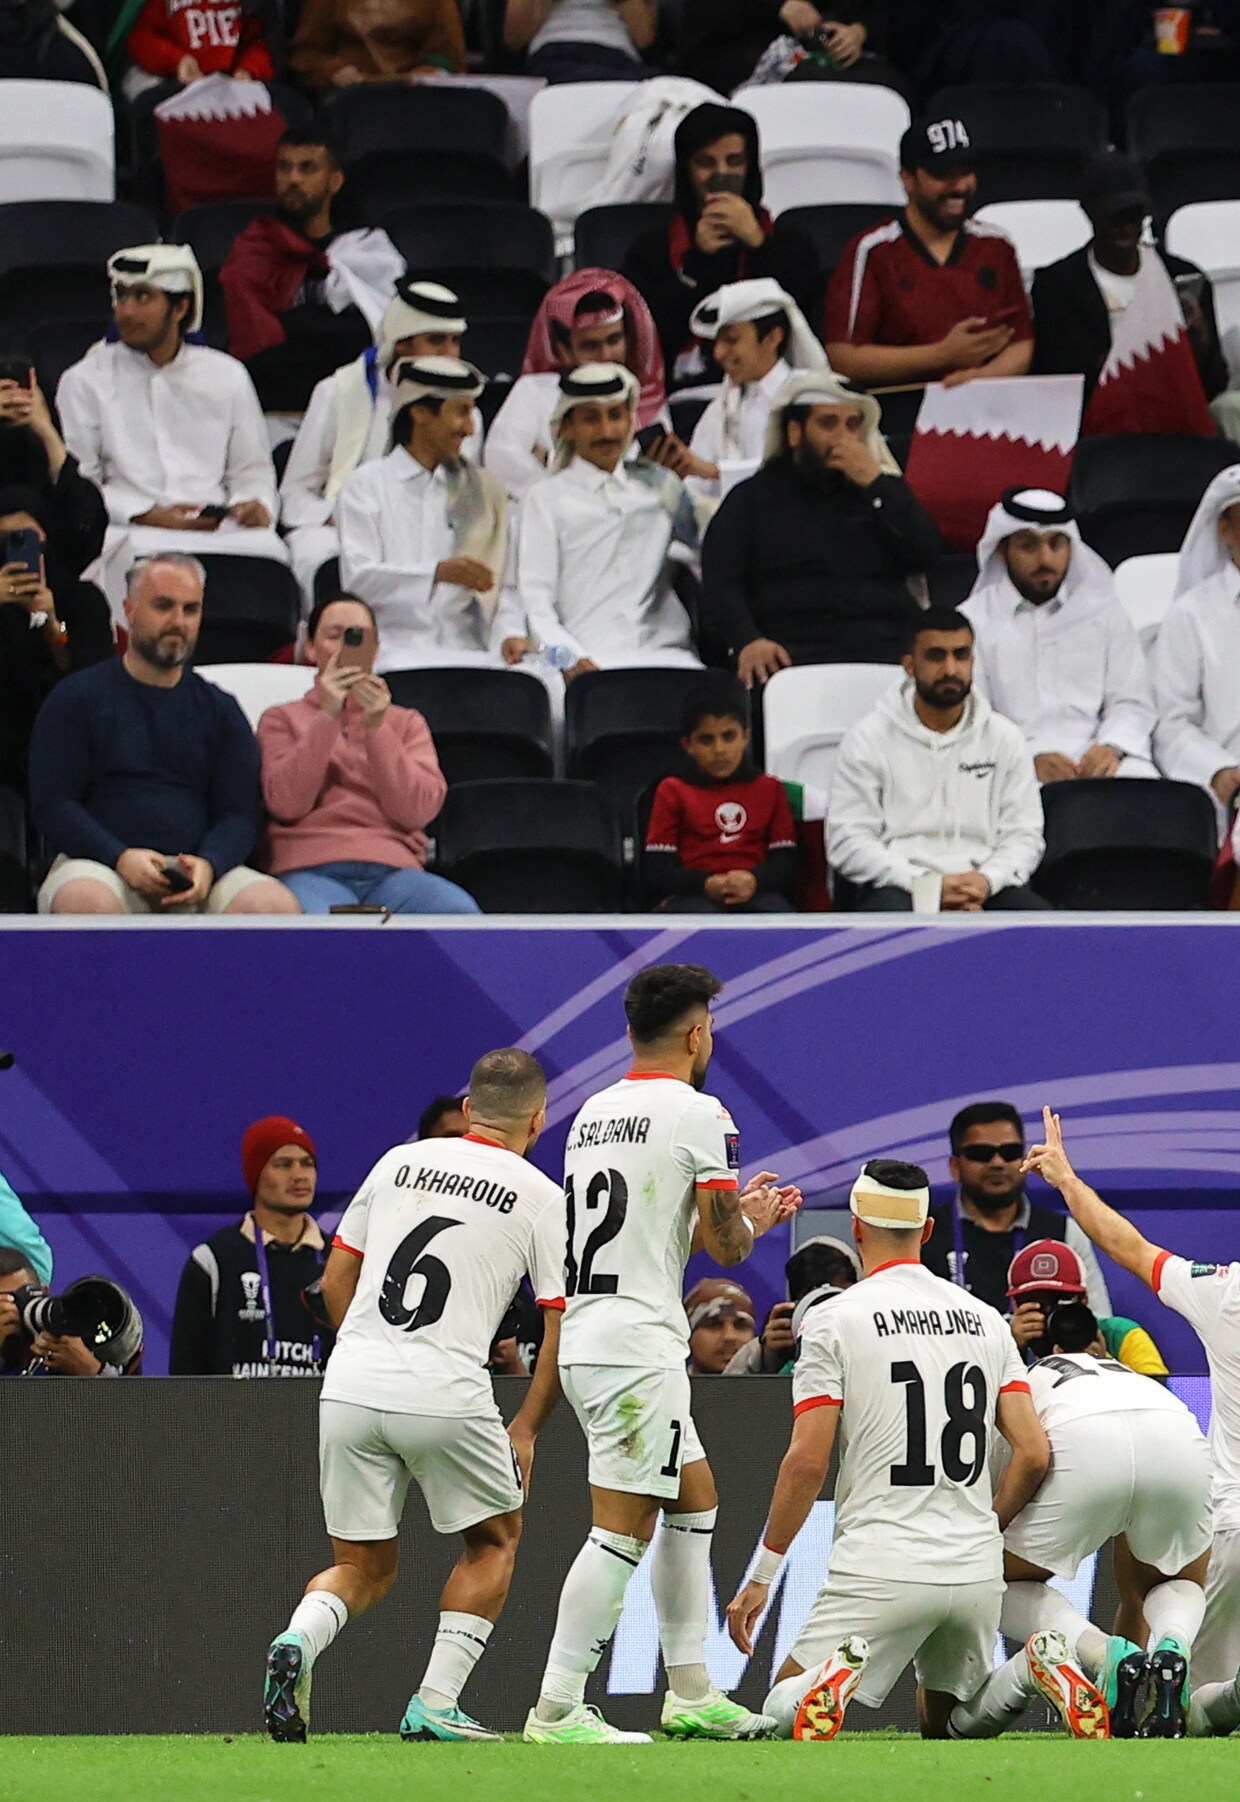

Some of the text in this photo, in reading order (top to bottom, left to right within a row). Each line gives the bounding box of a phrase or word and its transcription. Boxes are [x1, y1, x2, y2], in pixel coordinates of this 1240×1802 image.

[926, 119, 970, 153] 974
[394, 1165, 518, 1214] O.KHAROUB
[378, 1215, 466, 1332] 6
[565, 1168, 628, 1297] 12
[873, 1309, 986, 1337] A.MAHAJNEH
[890, 1360, 987, 1487] 18
